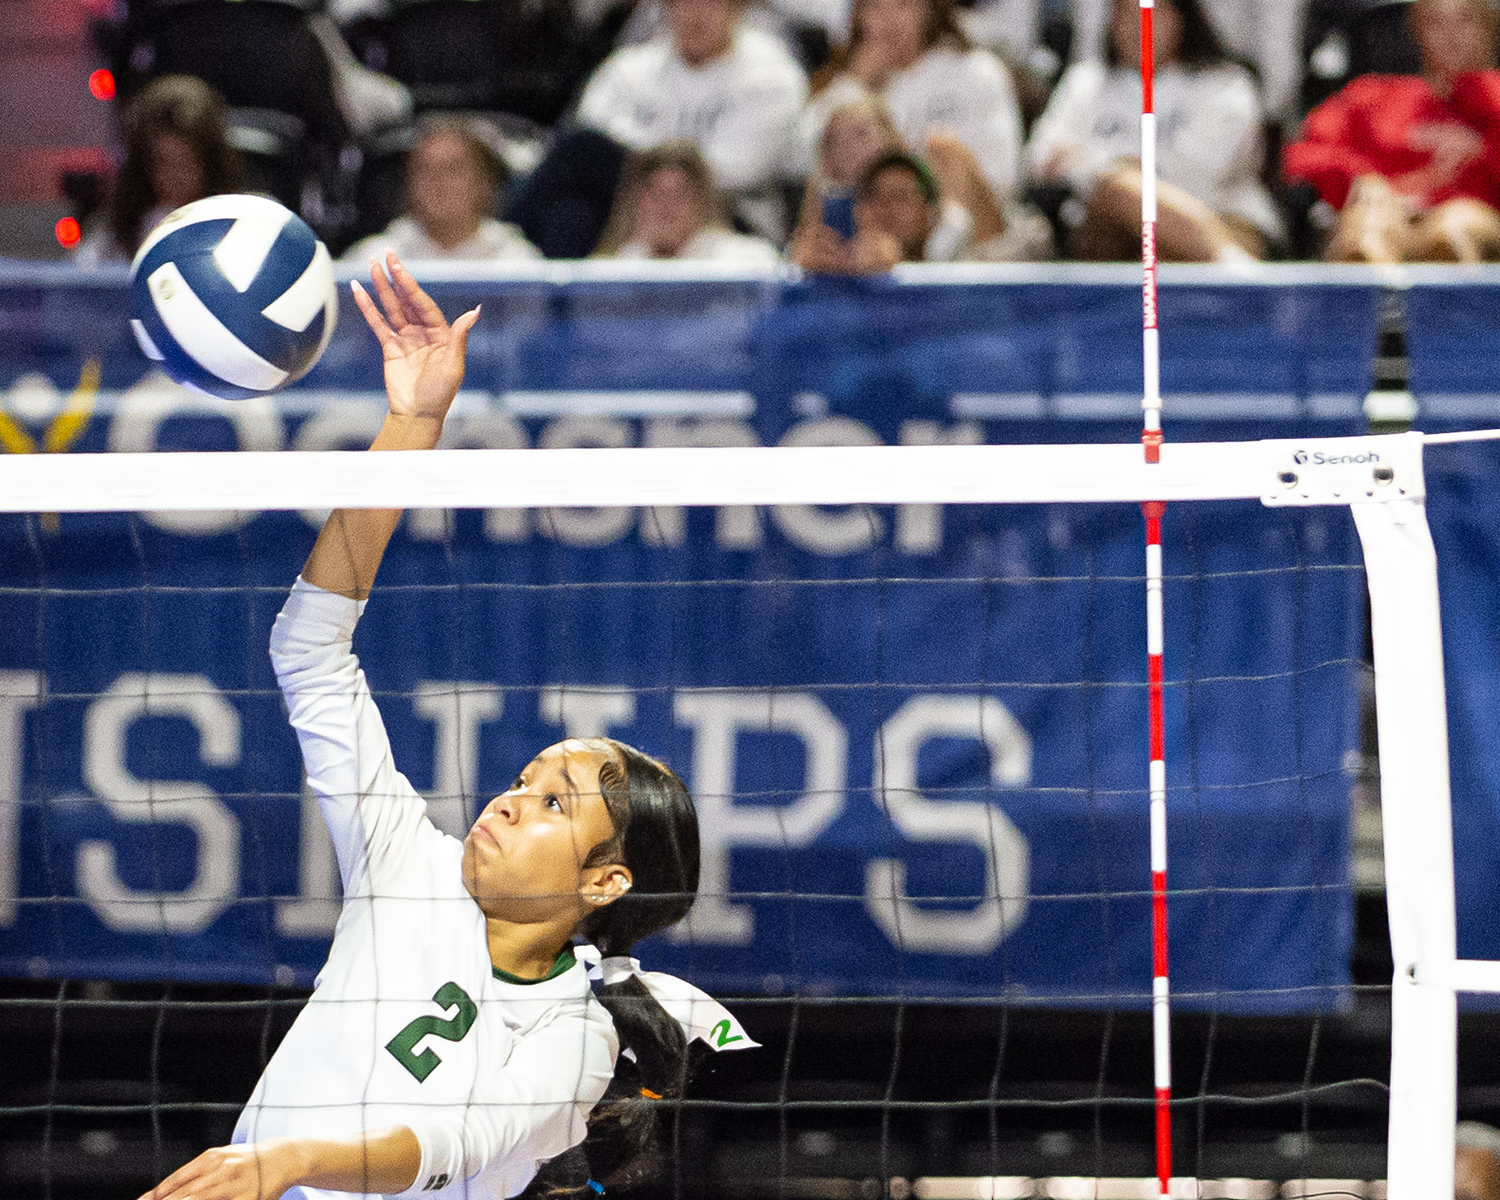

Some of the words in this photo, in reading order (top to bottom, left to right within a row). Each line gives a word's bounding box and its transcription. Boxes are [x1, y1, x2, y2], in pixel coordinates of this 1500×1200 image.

[1313, 450, 1380, 465] Senoh
[385, 981, 478, 1084] 2
[710, 1019, 743, 1047] 2
